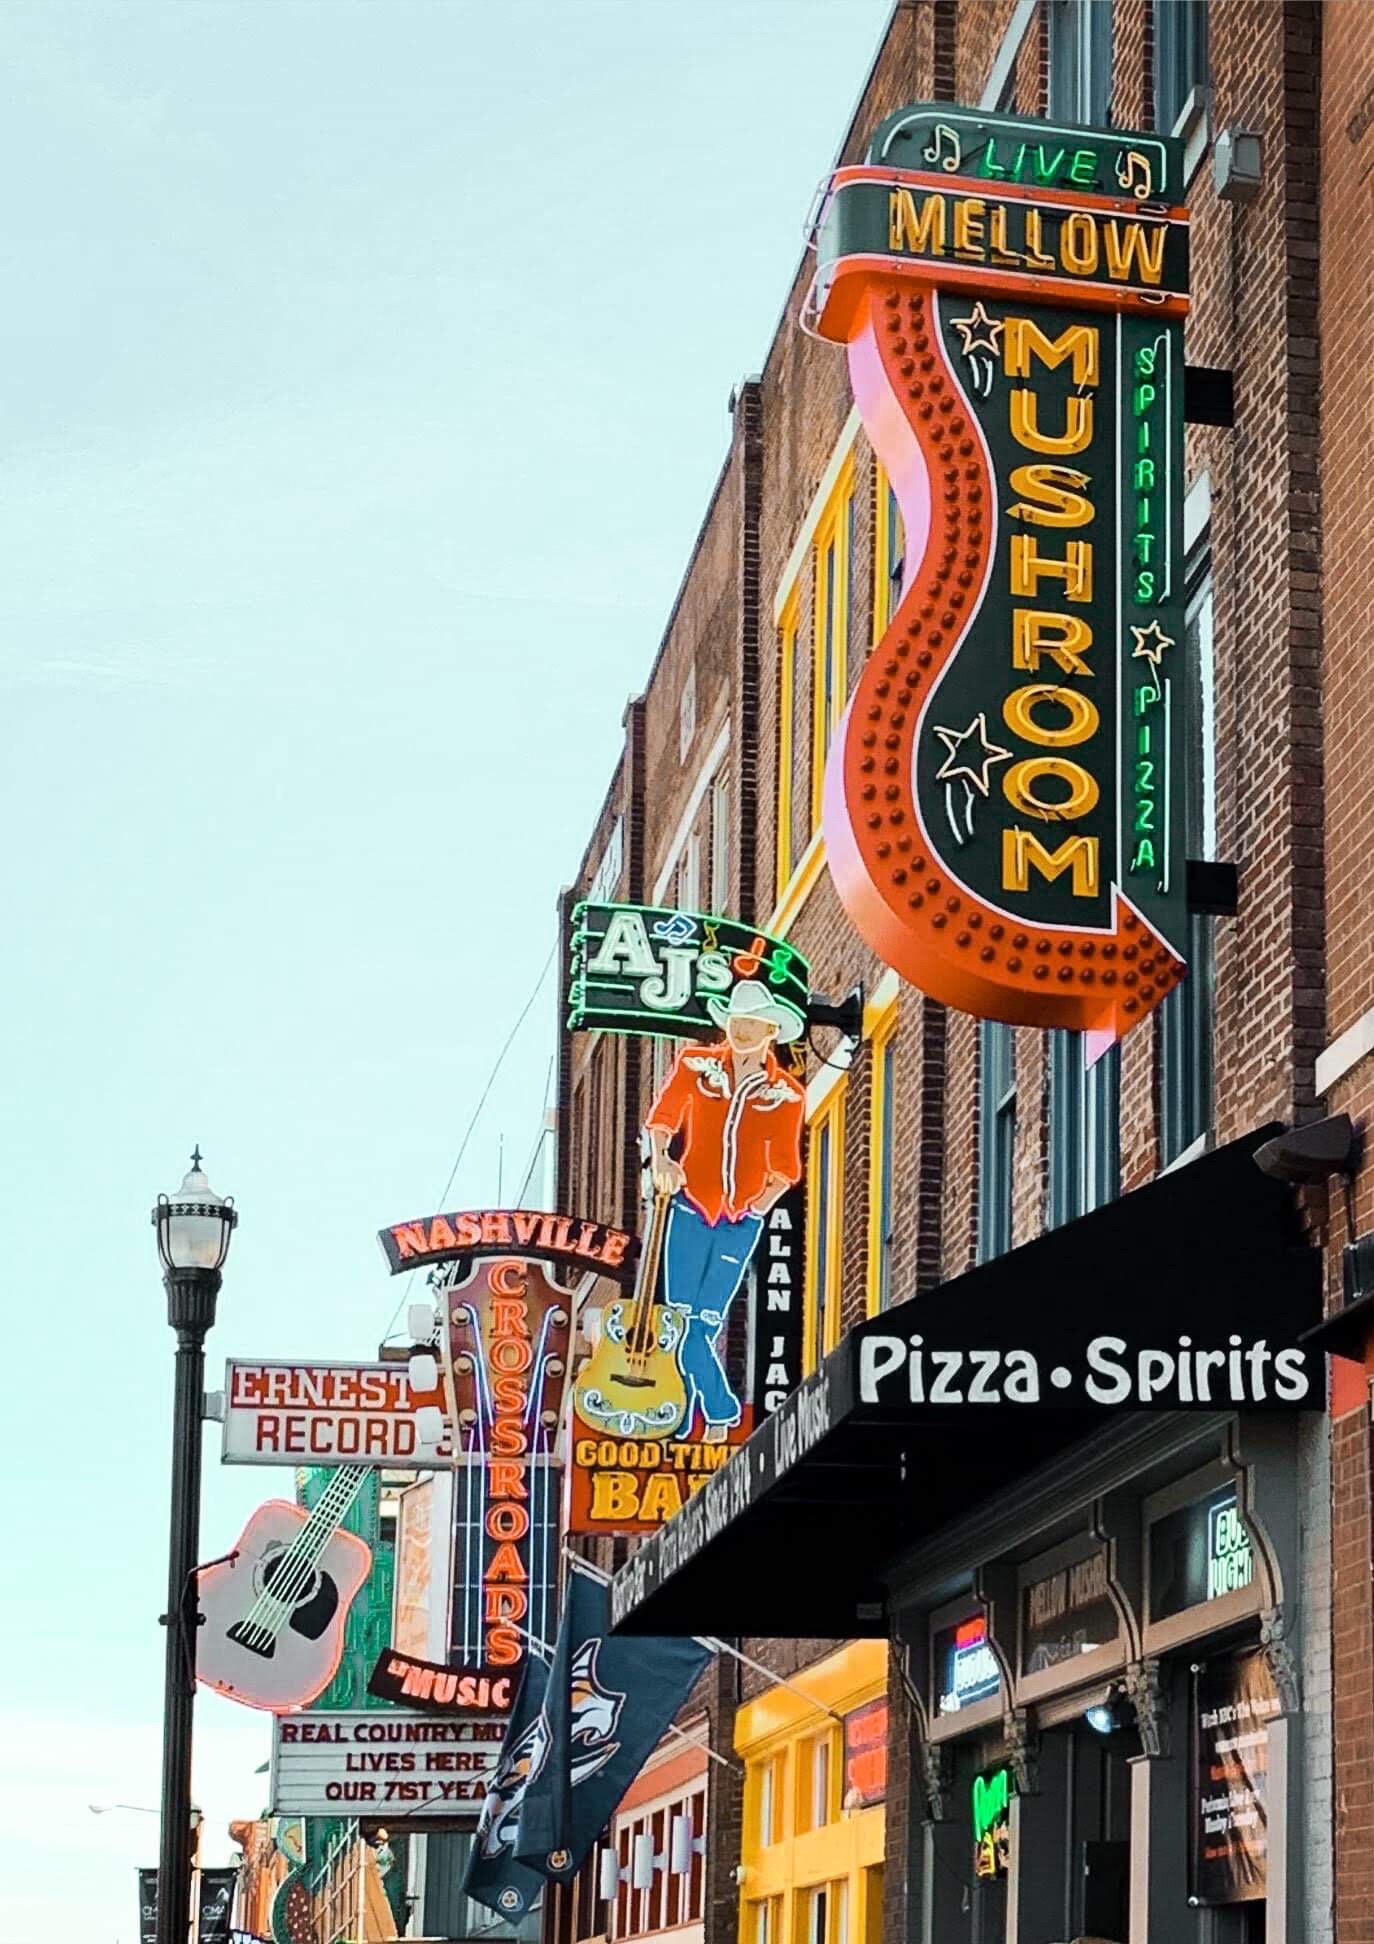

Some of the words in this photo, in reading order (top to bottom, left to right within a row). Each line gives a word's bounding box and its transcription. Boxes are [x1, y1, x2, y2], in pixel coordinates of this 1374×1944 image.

[978, 138, 1099, 191] LIVE
[889, 187, 1169, 284] MELLOW
[1133, 346, 1157, 605] SPIRITS
[1002, 316, 1100, 898] MUSHROOM
[1133, 686, 1156, 869] PIZZA
[392, 1209, 630, 1267] NASHVILLE
[768, 1208, 793, 1312] ALAN
[233, 1366, 411, 1409] ERNEST
[859, 1335, 1040, 1404] Pizza
[1085, 1335, 1309, 1405] Spirits
[256, 1414, 416, 1456] RECORD
[487, 1260, 533, 1665] CROSSROADS
[575, 1440, 661, 1468] GOOD
[401, 1667, 511, 1708] MUSIC
[281, 1723, 348, 1743] REAL
[353, 1723, 465, 1743] COUNTRY
[346, 1752, 416, 1772] LIVES
[425, 1752, 487, 1772] HERE
[325, 1781, 376, 1801] OUR
[384, 1781, 433, 1801] 71ST
